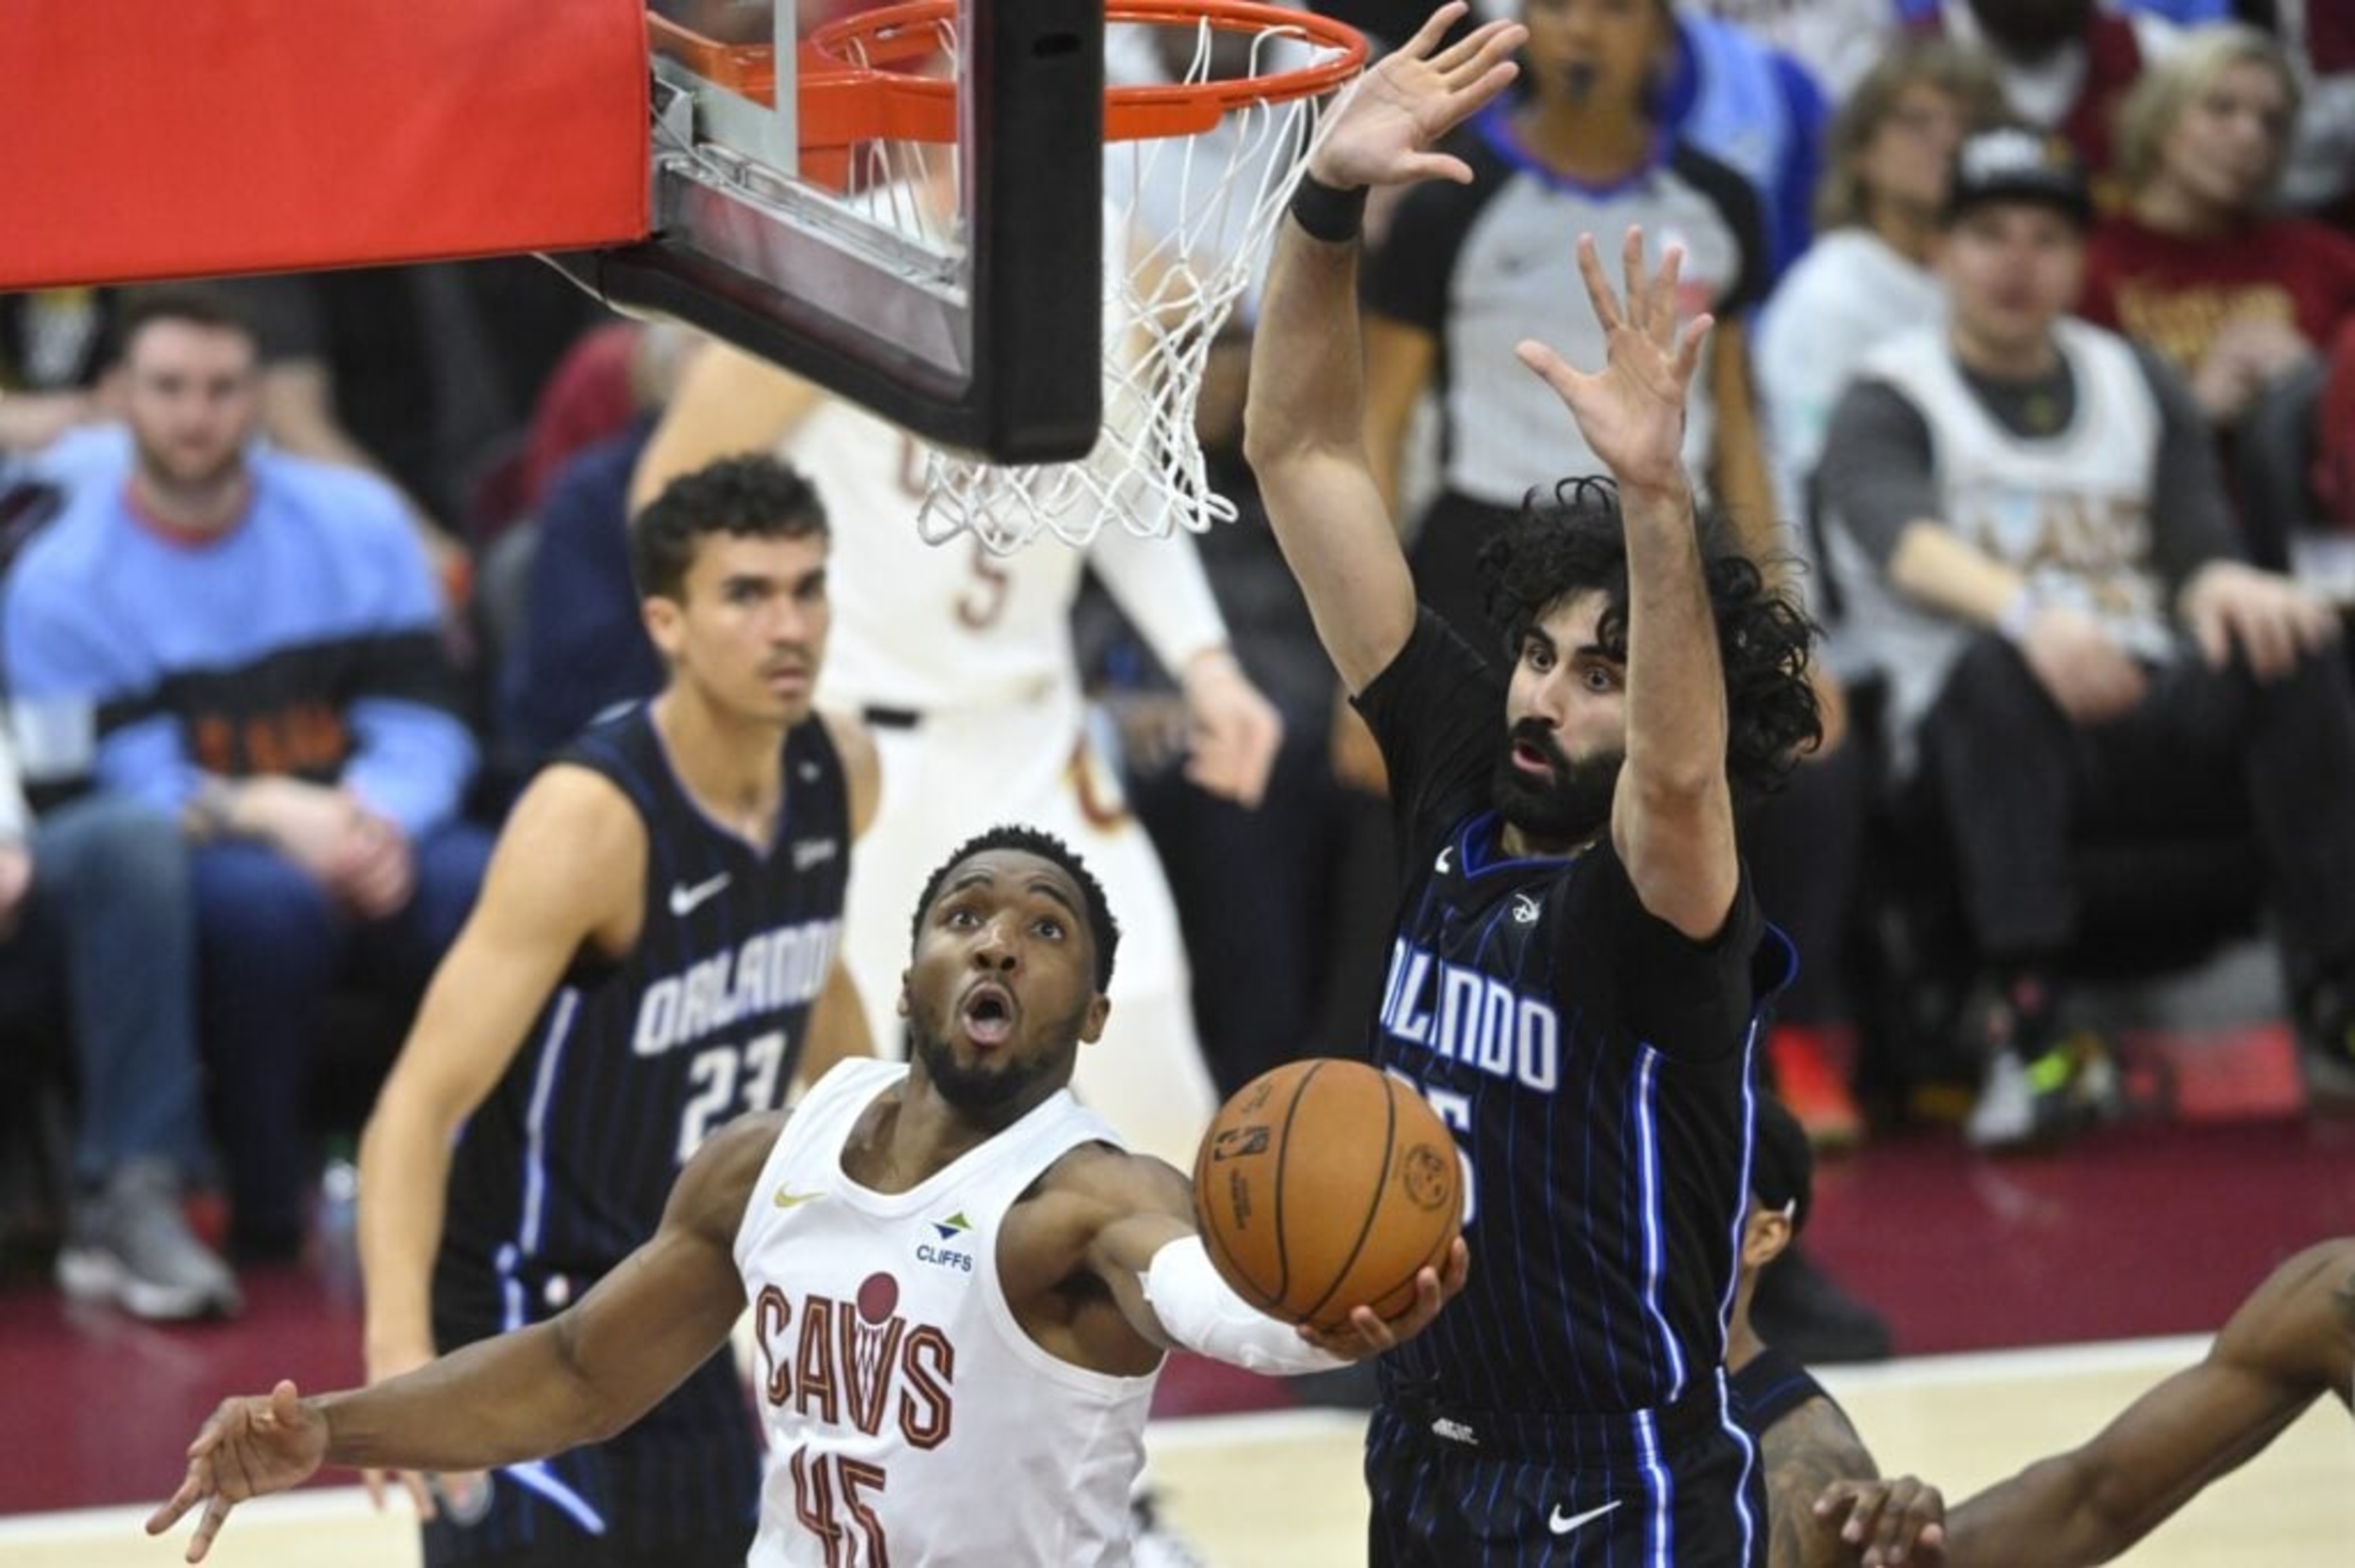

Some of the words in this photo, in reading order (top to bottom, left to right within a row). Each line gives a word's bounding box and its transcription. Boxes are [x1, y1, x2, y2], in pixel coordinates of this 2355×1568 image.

[675, 1029, 786, 1166] 23
[917, 1244, 972, 1272] CLIFFS
[755, 1284, 954, 1451] CAVS
[790, 1444, 890, 1568] 45
